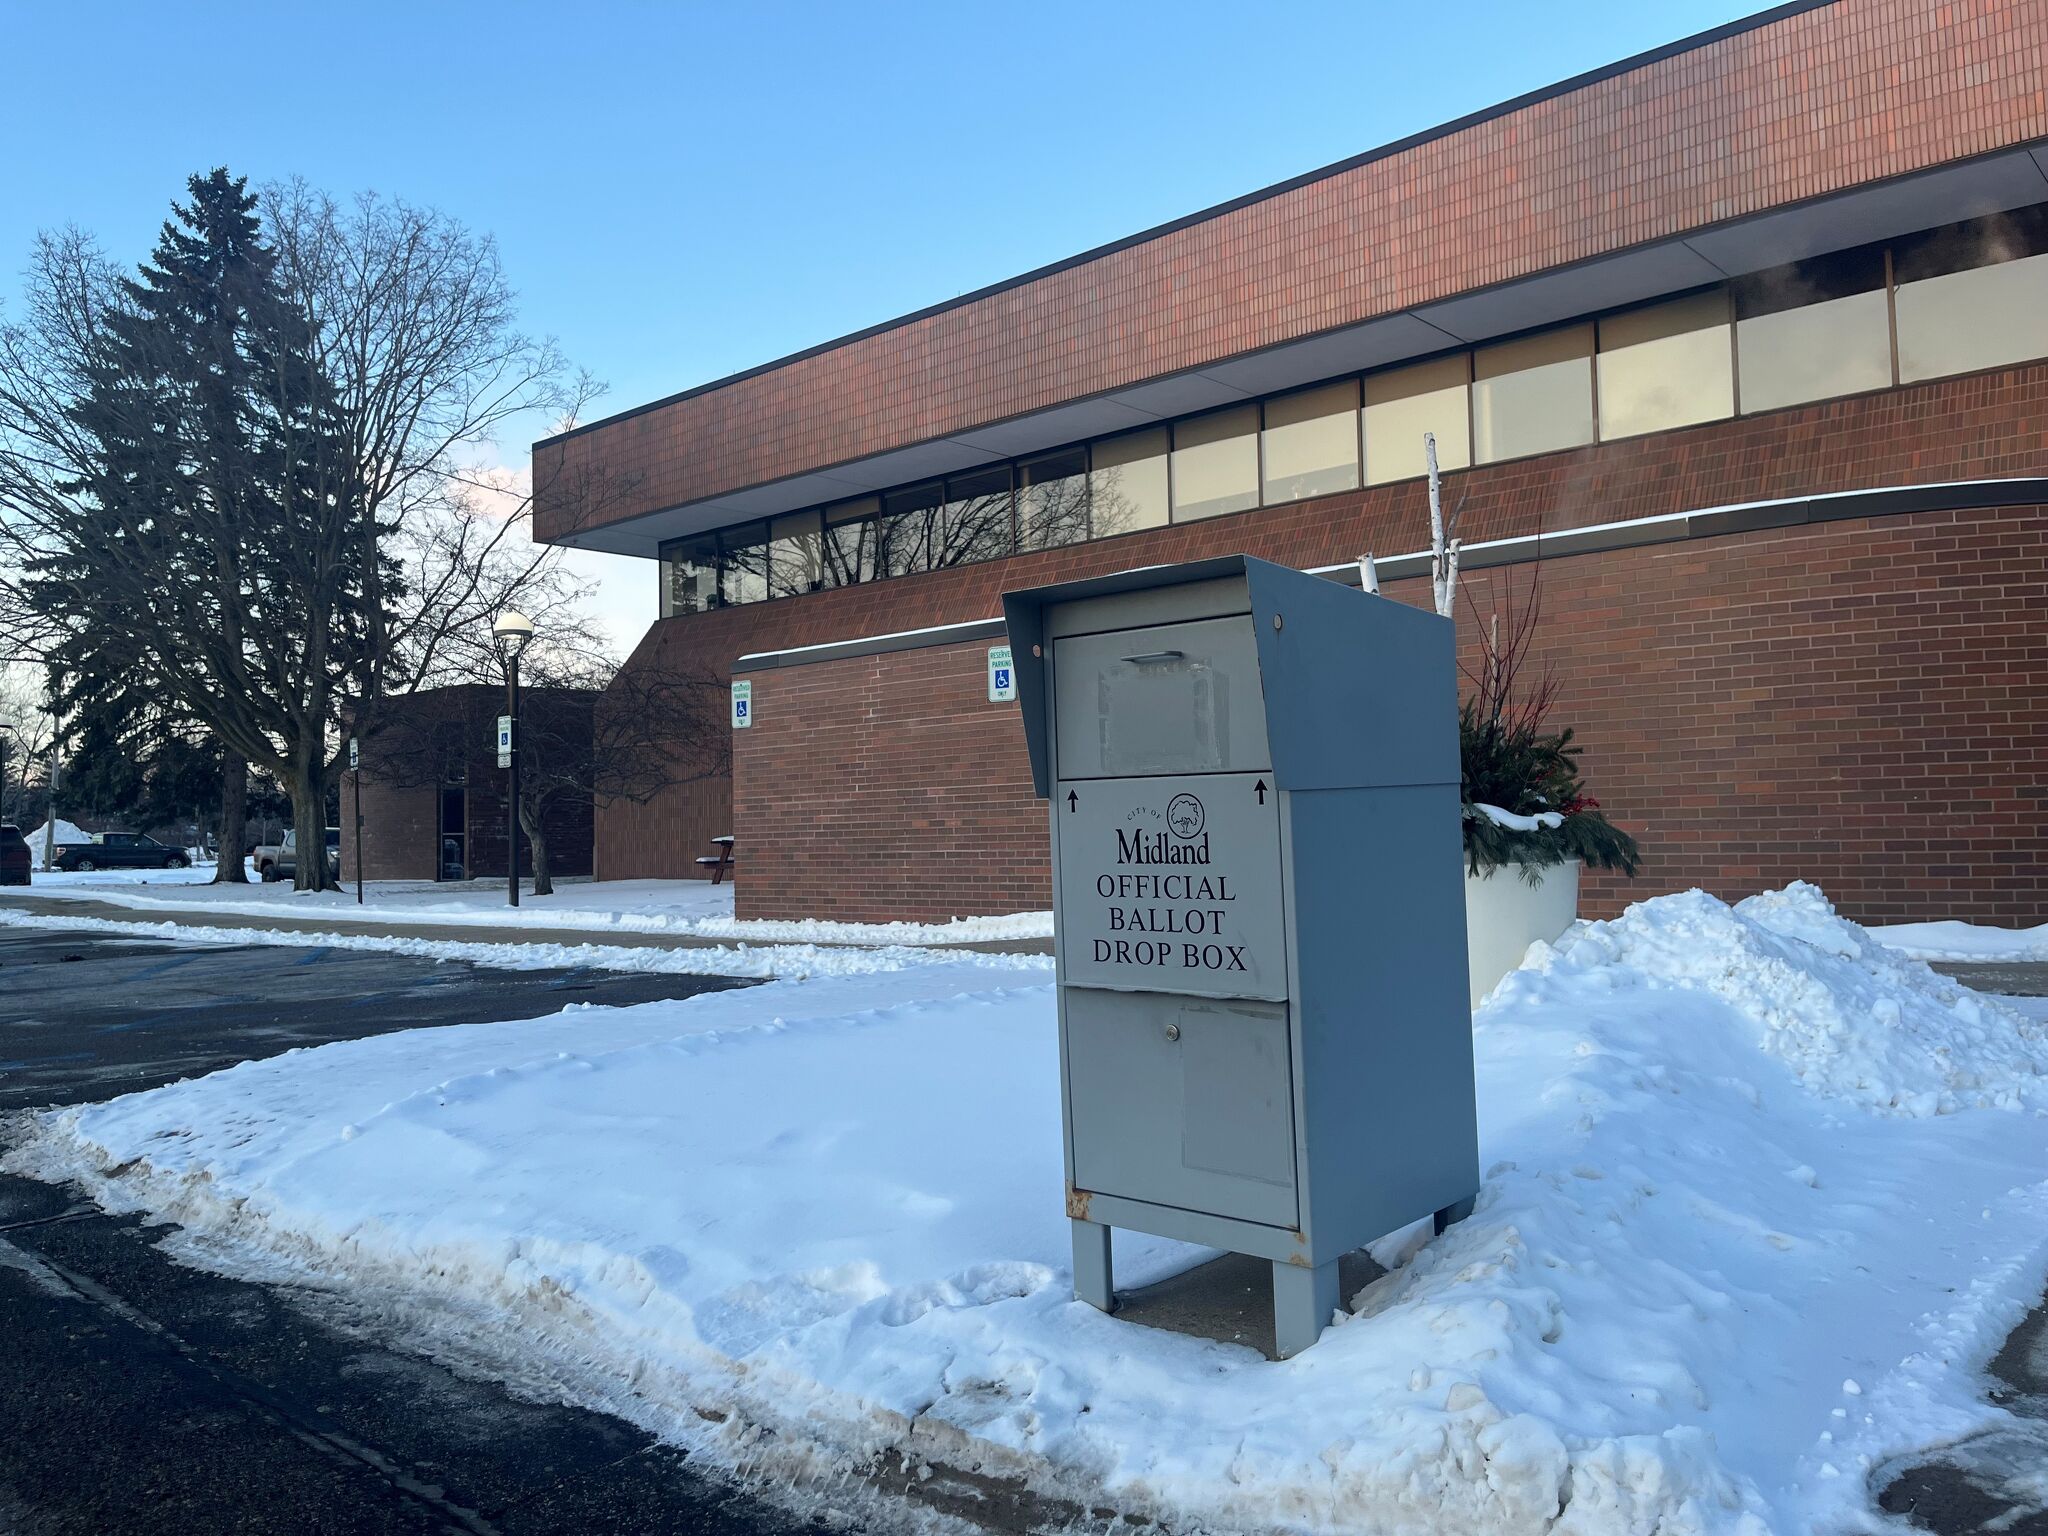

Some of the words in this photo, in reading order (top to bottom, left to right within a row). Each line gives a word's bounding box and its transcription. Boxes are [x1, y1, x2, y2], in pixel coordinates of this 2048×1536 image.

[990, 650, 1011, 659] RESERVE
[992, 660, 1011, 668] PARKING
[1127, 806, 1147, 821] CITY
[1150, 809, 1162, 820] OF
[1115, 828, 1211, 865] Midland
[1096, 874, 1237, 901] OFFICIAL
[1108, 907, 1226, 935] BALLOT
[1093, 939, 1172, 966] DROP
[1182, 943, 1248, 971] BOX
